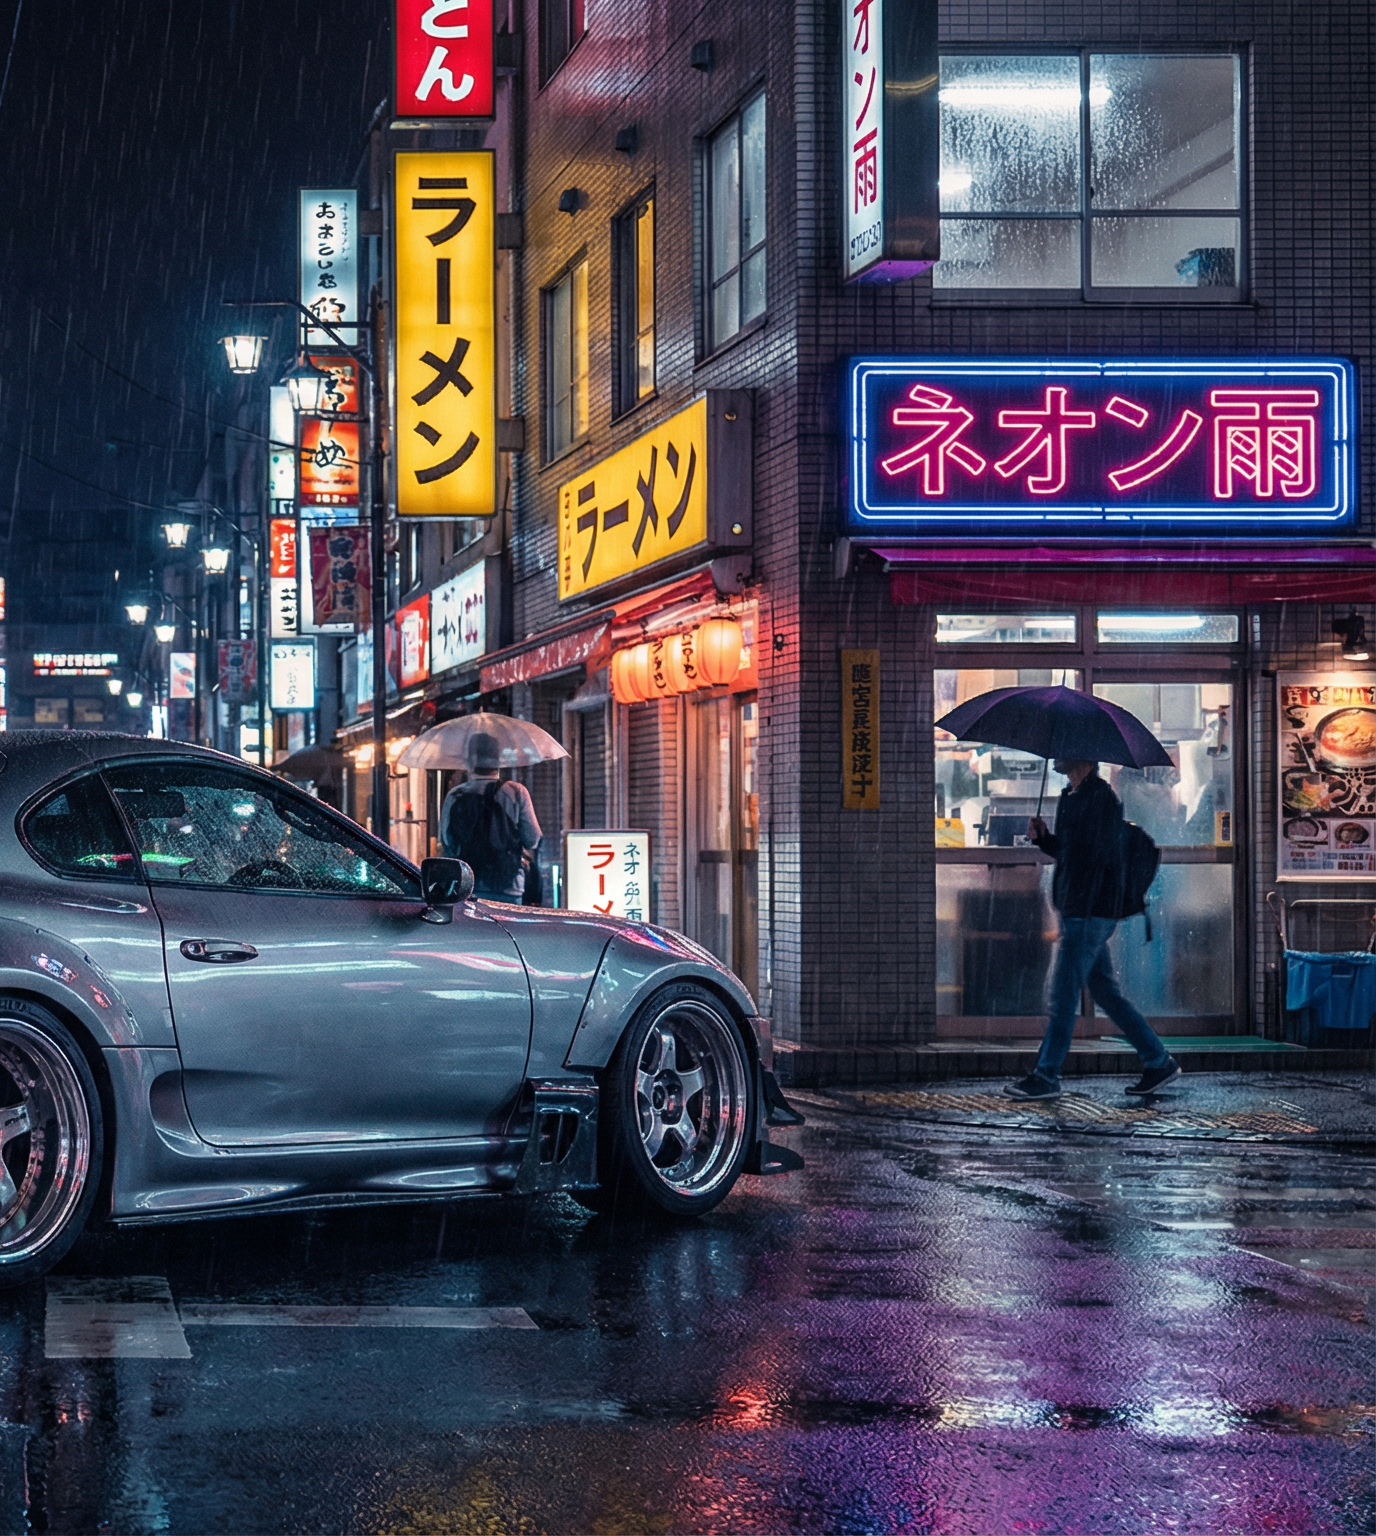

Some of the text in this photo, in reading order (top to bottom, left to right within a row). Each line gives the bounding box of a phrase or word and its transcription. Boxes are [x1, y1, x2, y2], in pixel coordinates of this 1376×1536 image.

[412, 177, 480, 485] ラーメン
[577, 440, 698, 583] ラーメン
[882, 385, 1319, 498] ネオン雨
